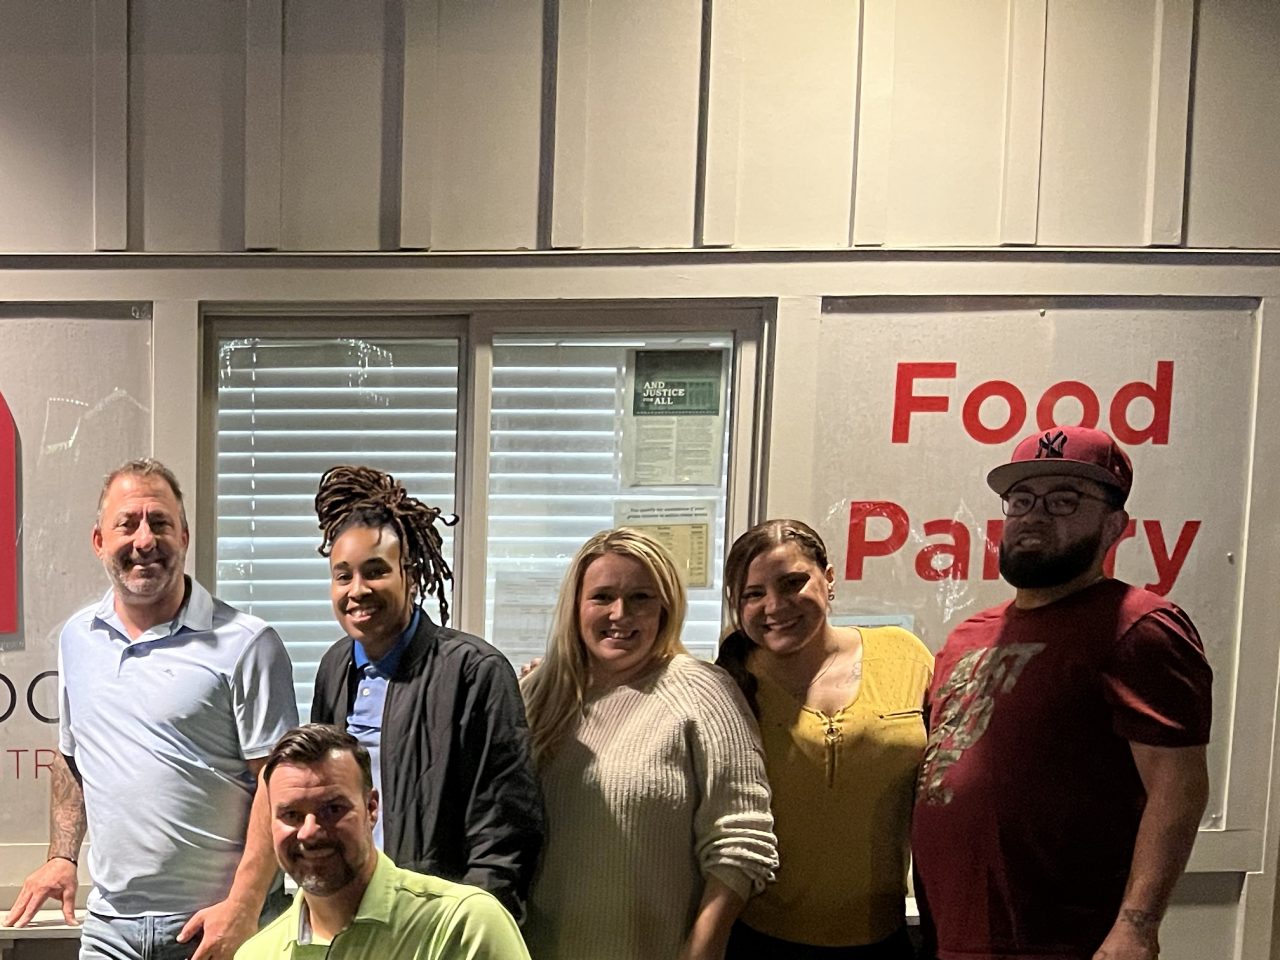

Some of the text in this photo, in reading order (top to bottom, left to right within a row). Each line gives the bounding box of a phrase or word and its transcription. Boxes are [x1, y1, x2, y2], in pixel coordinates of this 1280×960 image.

[643, 381, 665, 389] AND
[643, 388, 685, 397] JUSTICE
[654, 397, 674, 405] ALL
[891, 360, 1175, 446] Food
[844, 501, 1202, 597] Pary
